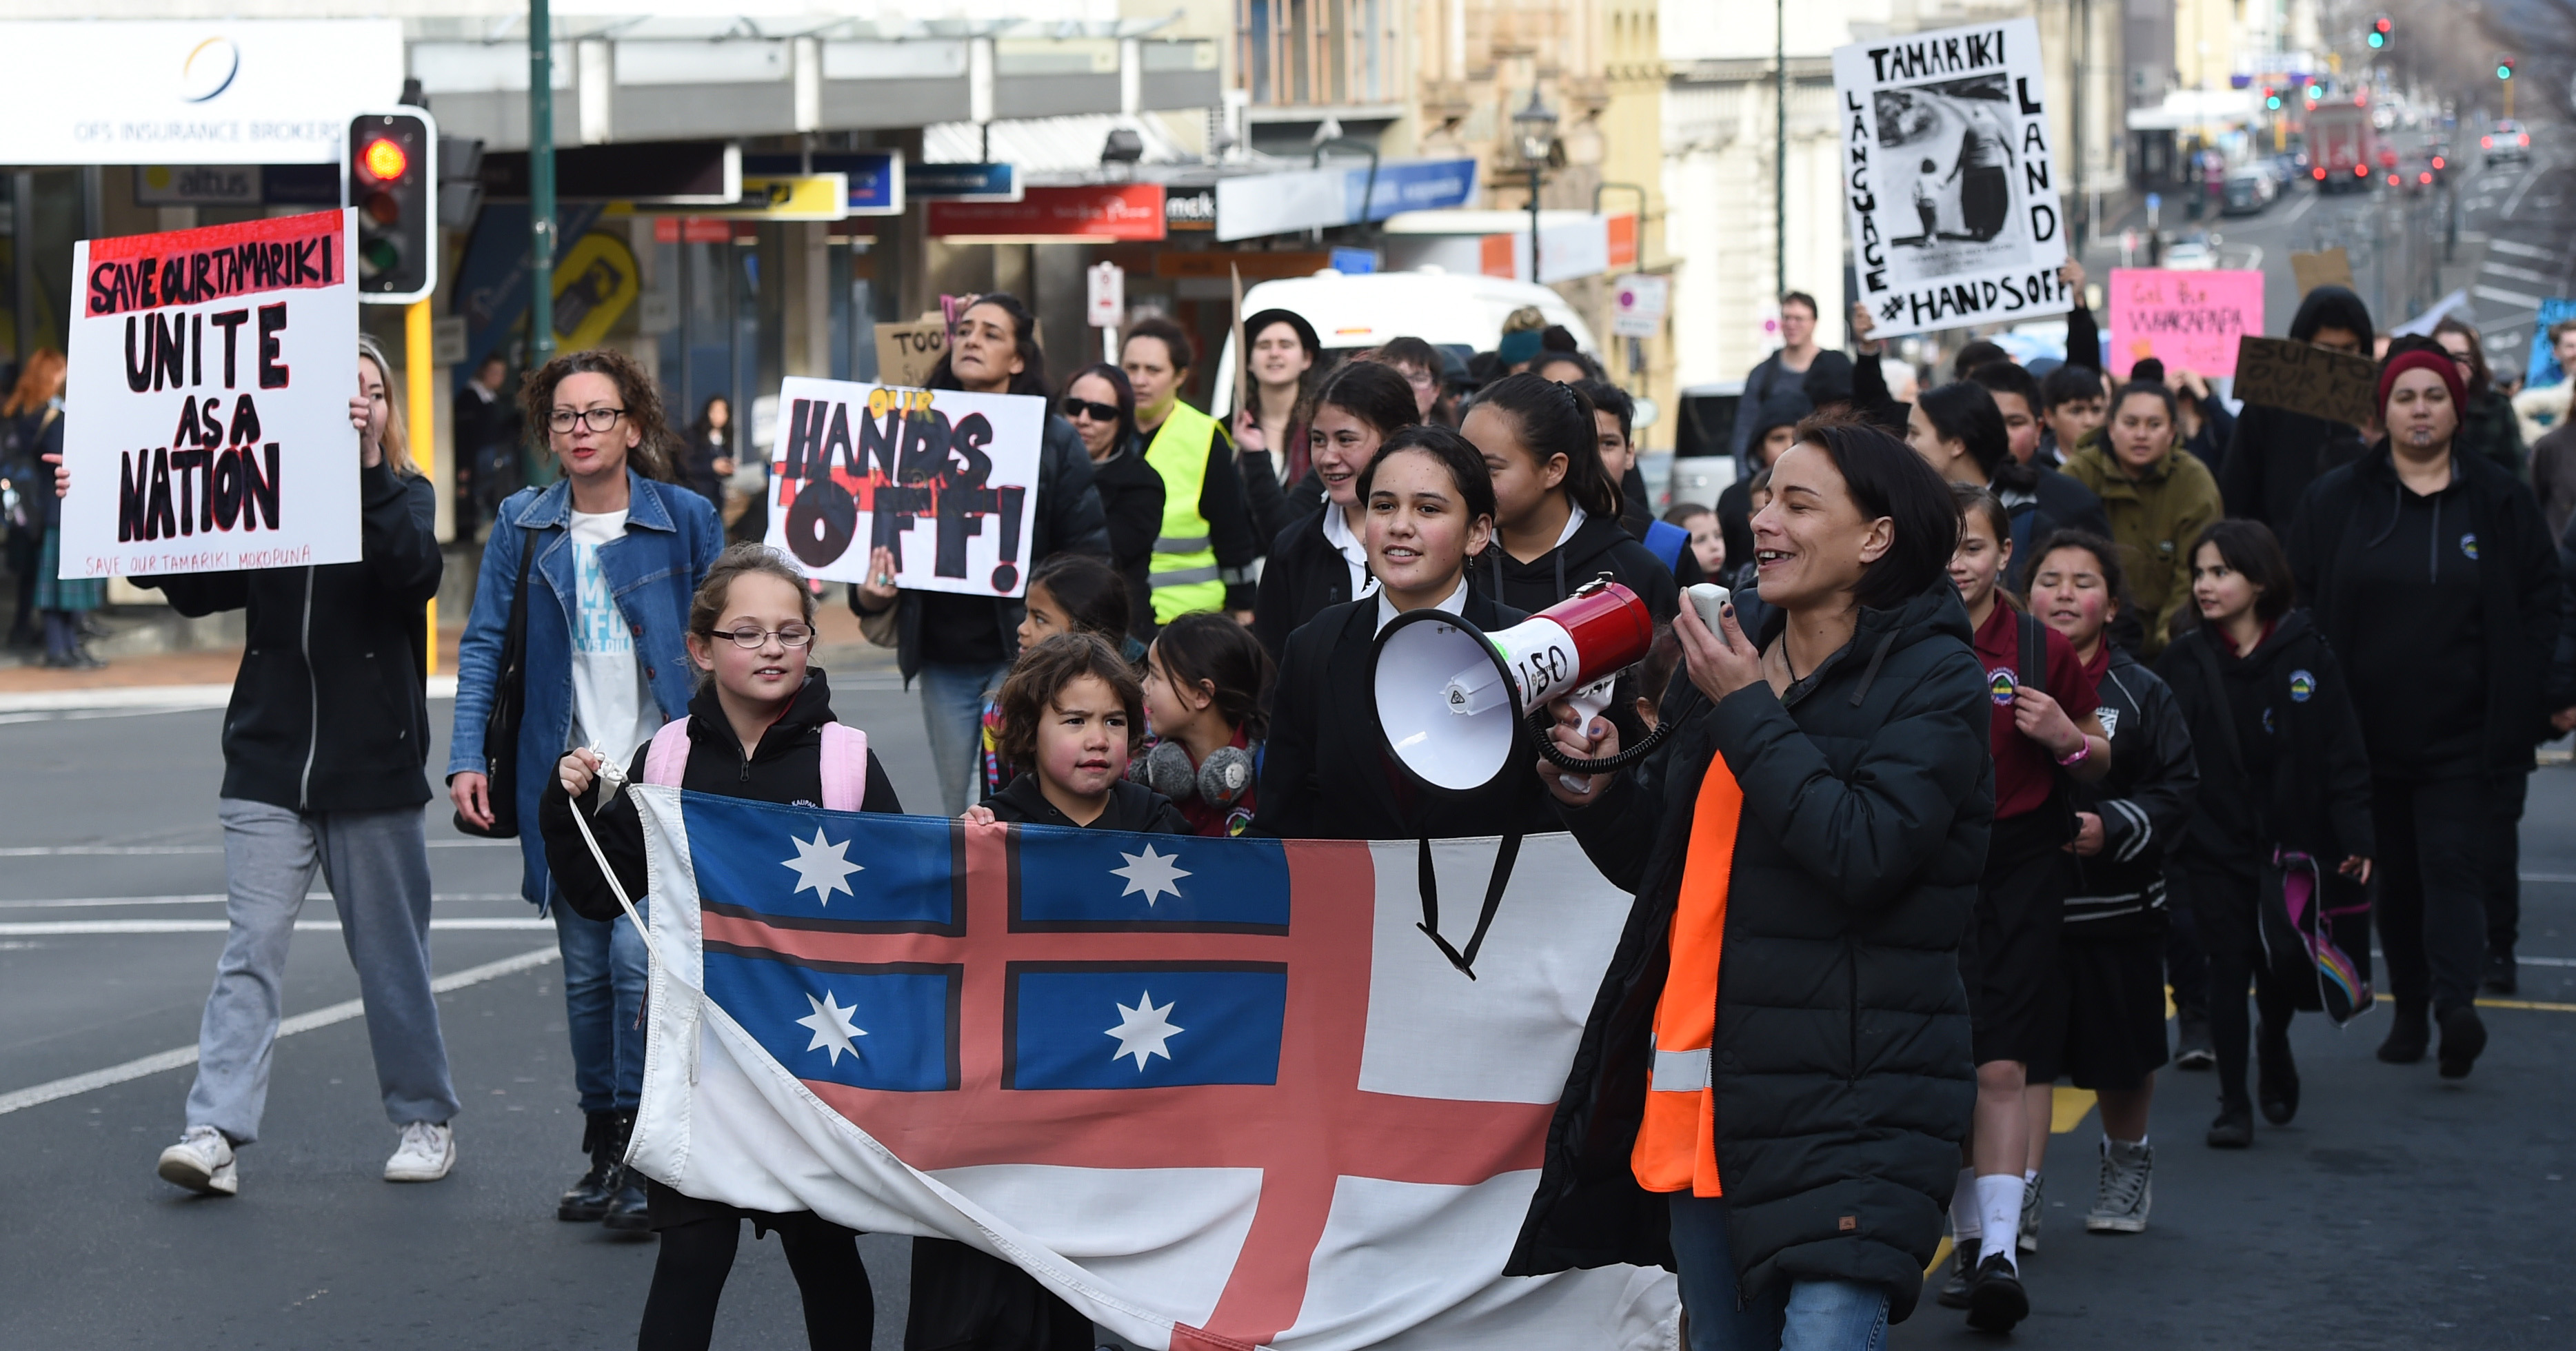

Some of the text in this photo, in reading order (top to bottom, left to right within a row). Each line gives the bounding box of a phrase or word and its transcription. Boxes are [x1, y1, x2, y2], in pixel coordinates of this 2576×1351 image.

[1869, 30, 2005, 82] TAMARIKI
[120, 119, 240, 143] INSURANCE
[248, 119, 342, 142] BROKERS
[2016, 77, 2055, 242] LAND
[1847, 90, 1888, 293] LANGUAGE
[90, 235, 332, 314] SAVE OUR TAMARIKI
[125, 301, 290, 392] UNITE
[892, 332, 945, 356] TOO
[174, 394, 261, 449] AS A
[785, 398, 993, 489] HANDS
[869, 388, 934, 423] OUR
[118, 443, 280, 542] NATION
[86, 544, 311, 576] SAVE OUR TAMARIKI MOKOPUNA
[785, 478, 1026, 593] OFF!
